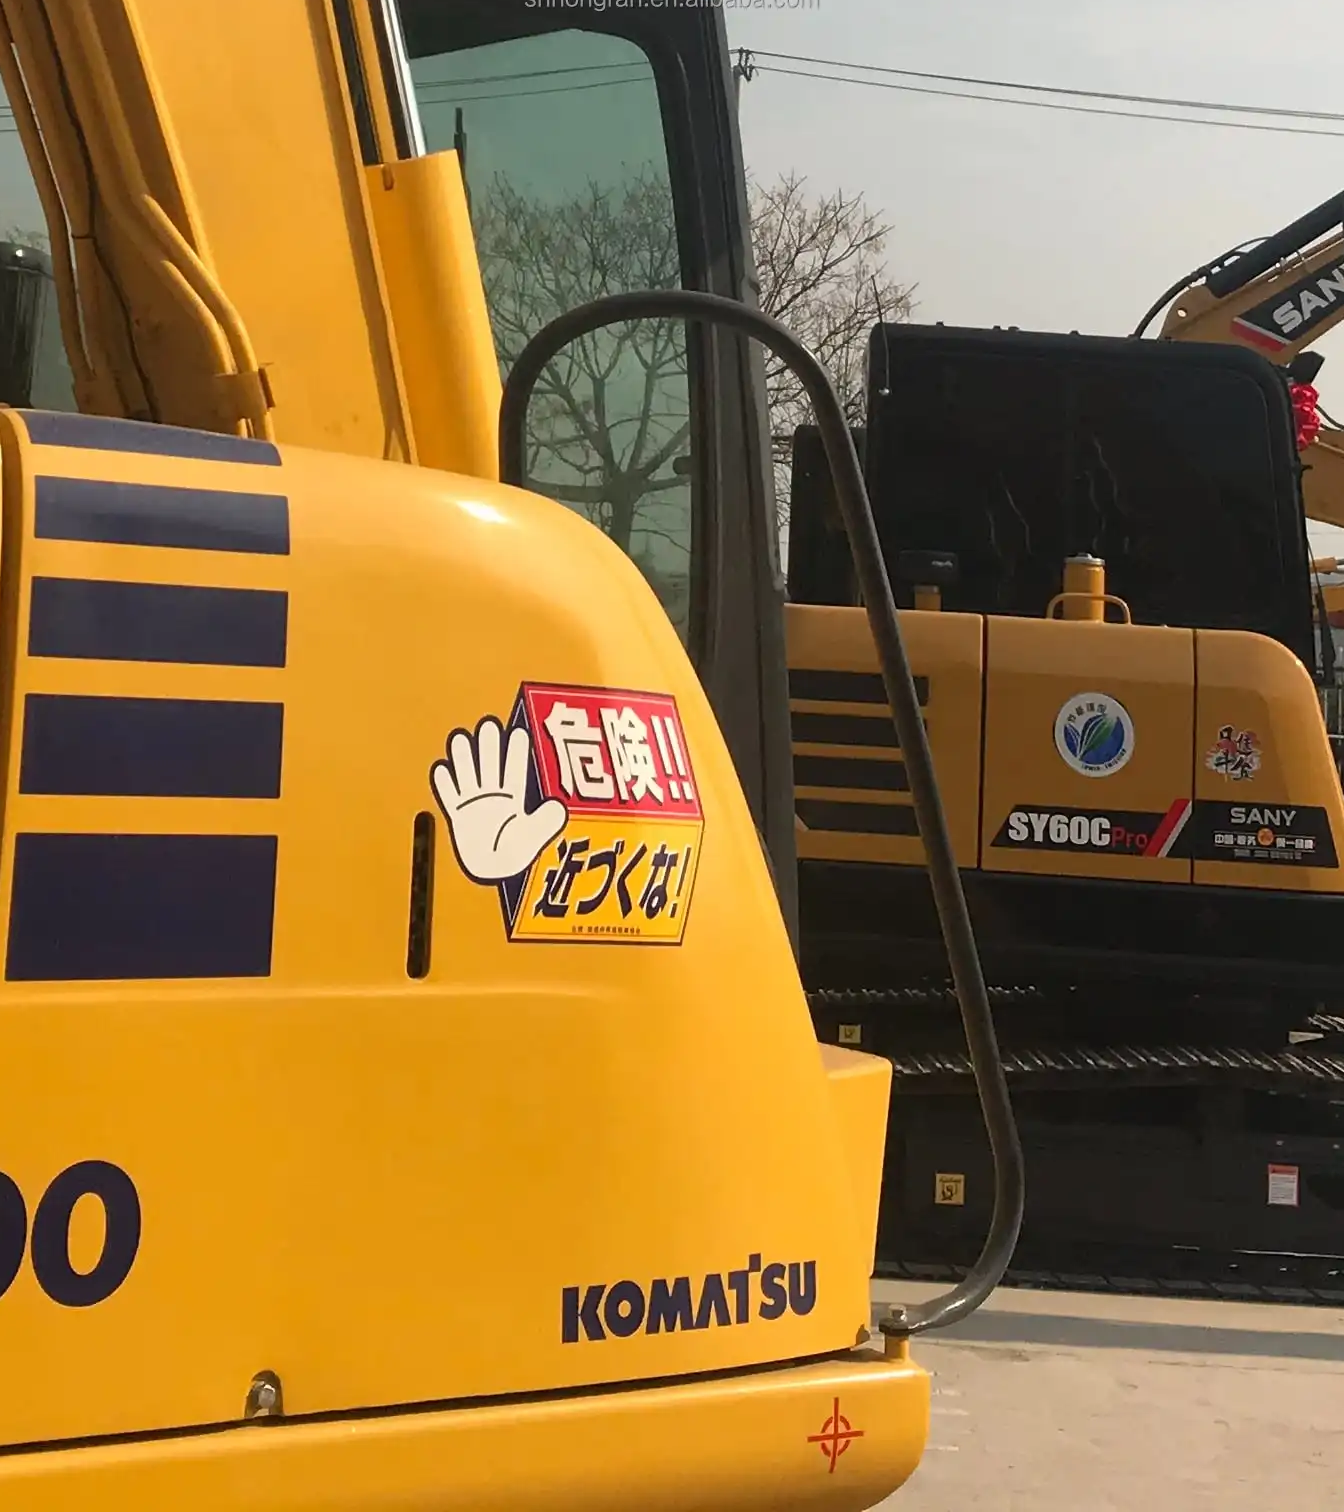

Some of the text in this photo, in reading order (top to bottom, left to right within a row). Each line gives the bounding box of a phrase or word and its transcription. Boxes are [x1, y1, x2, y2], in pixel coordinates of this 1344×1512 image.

[1008, 812, 1148, 848] SY60C Pro
[1230, 807, 1296, 826] SANY
[534, 838, 690, 919] 近づくな!
[562, 1253, 816, 1343] KOMATSU
